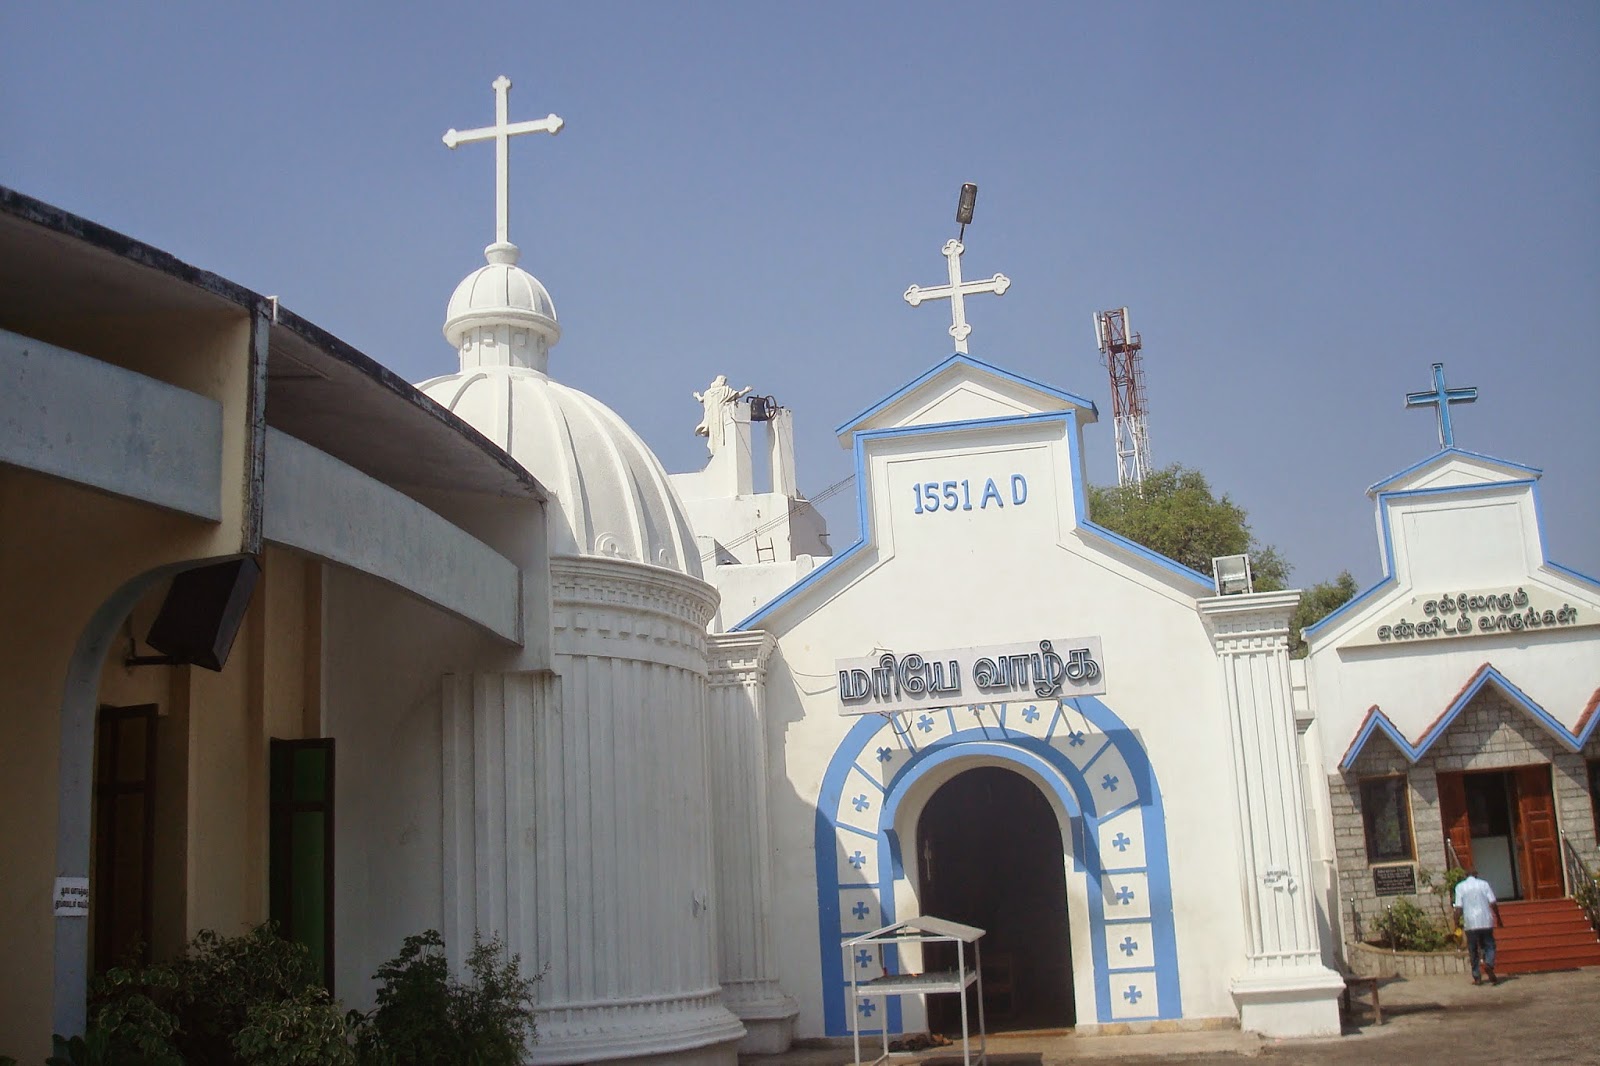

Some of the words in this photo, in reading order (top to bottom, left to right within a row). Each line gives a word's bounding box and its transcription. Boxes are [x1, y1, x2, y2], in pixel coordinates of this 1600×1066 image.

[912, 479, 973, 515] 1551
[1423, 587, 1528, 615] எல்லோரும்
[1377, 613, 1472, 641] என்னிடம்
[1478, 604, 1577, 632] வாருங்கள்
[839, 653, 961, 703] மரியே
[972, 639, 1101, 698] வாழ்க
